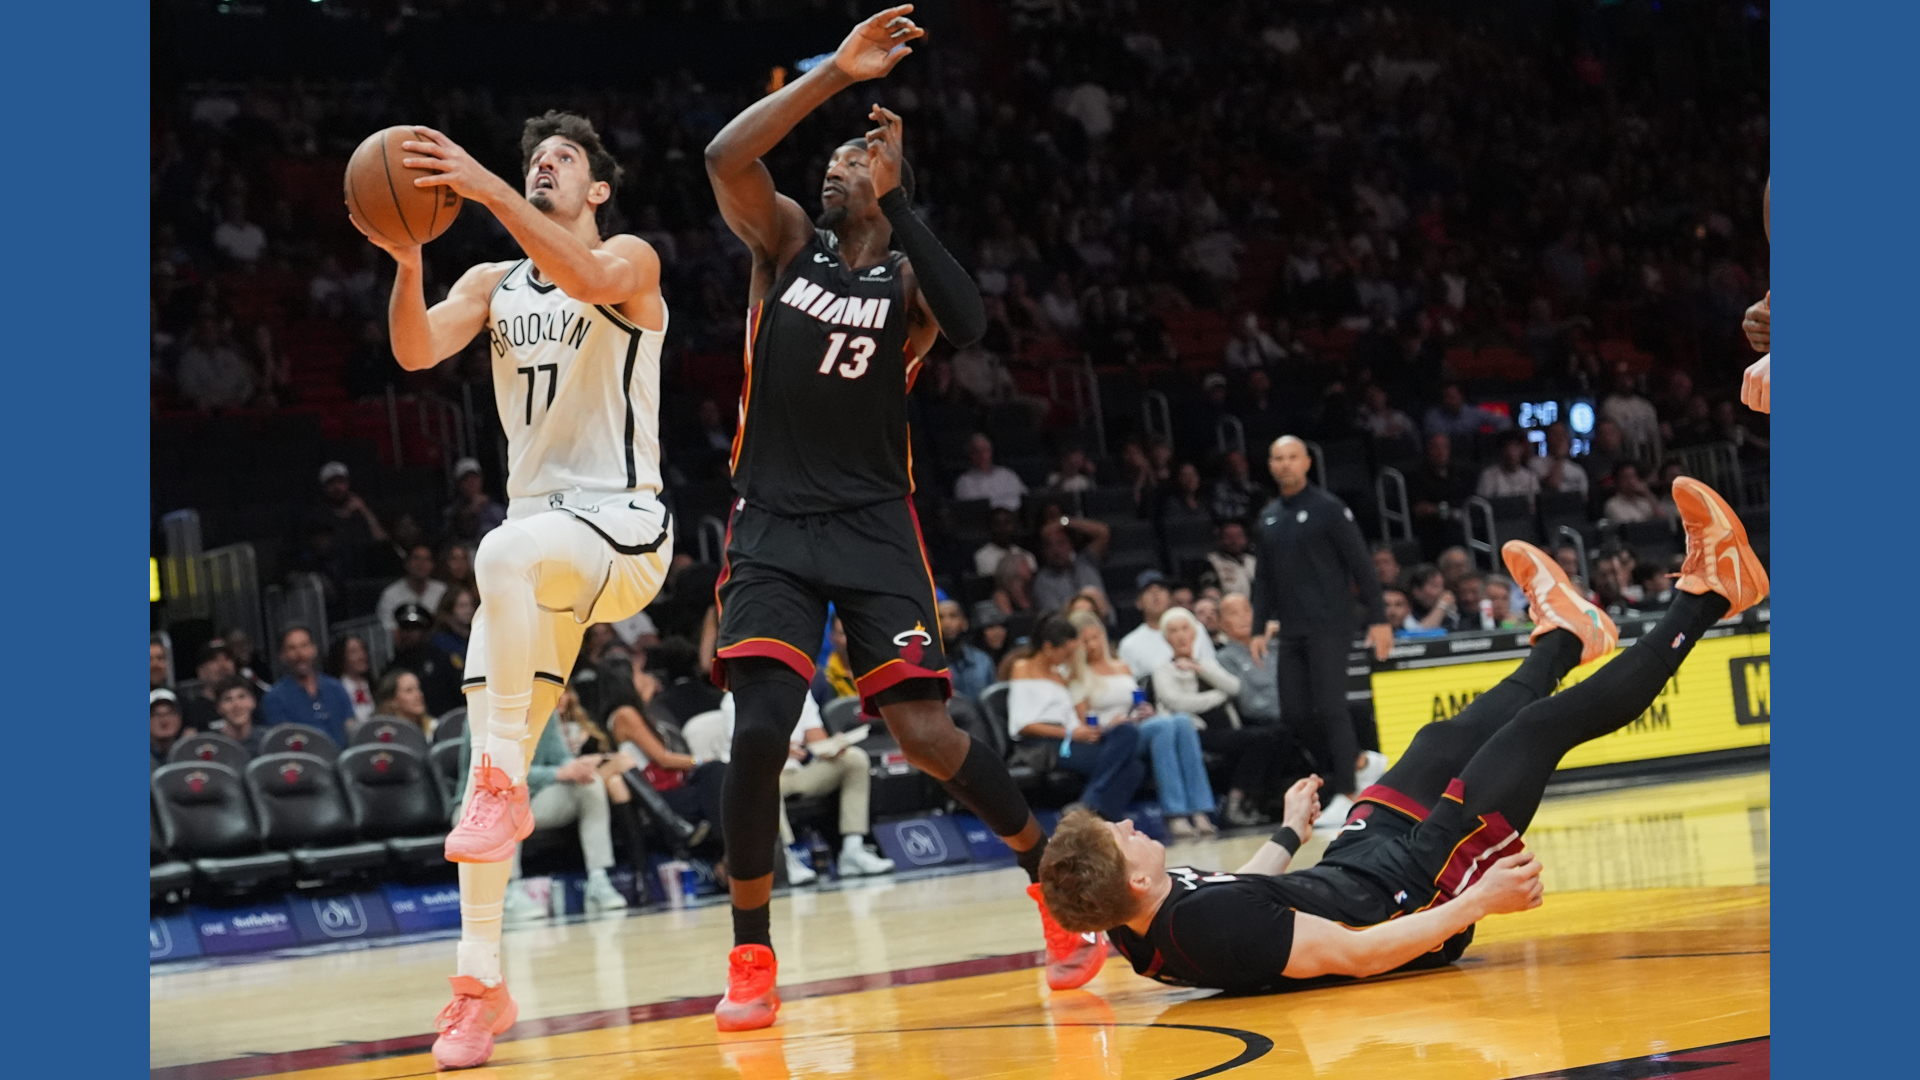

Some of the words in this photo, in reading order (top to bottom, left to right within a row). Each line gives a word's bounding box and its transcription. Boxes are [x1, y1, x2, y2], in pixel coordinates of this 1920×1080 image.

[780, 277, 892, 330] MIAMI
[490, 310, 592, 358] BROOKLYN
[818, 332, 877, 380] 13
[517, 363, 558, 426] 77
